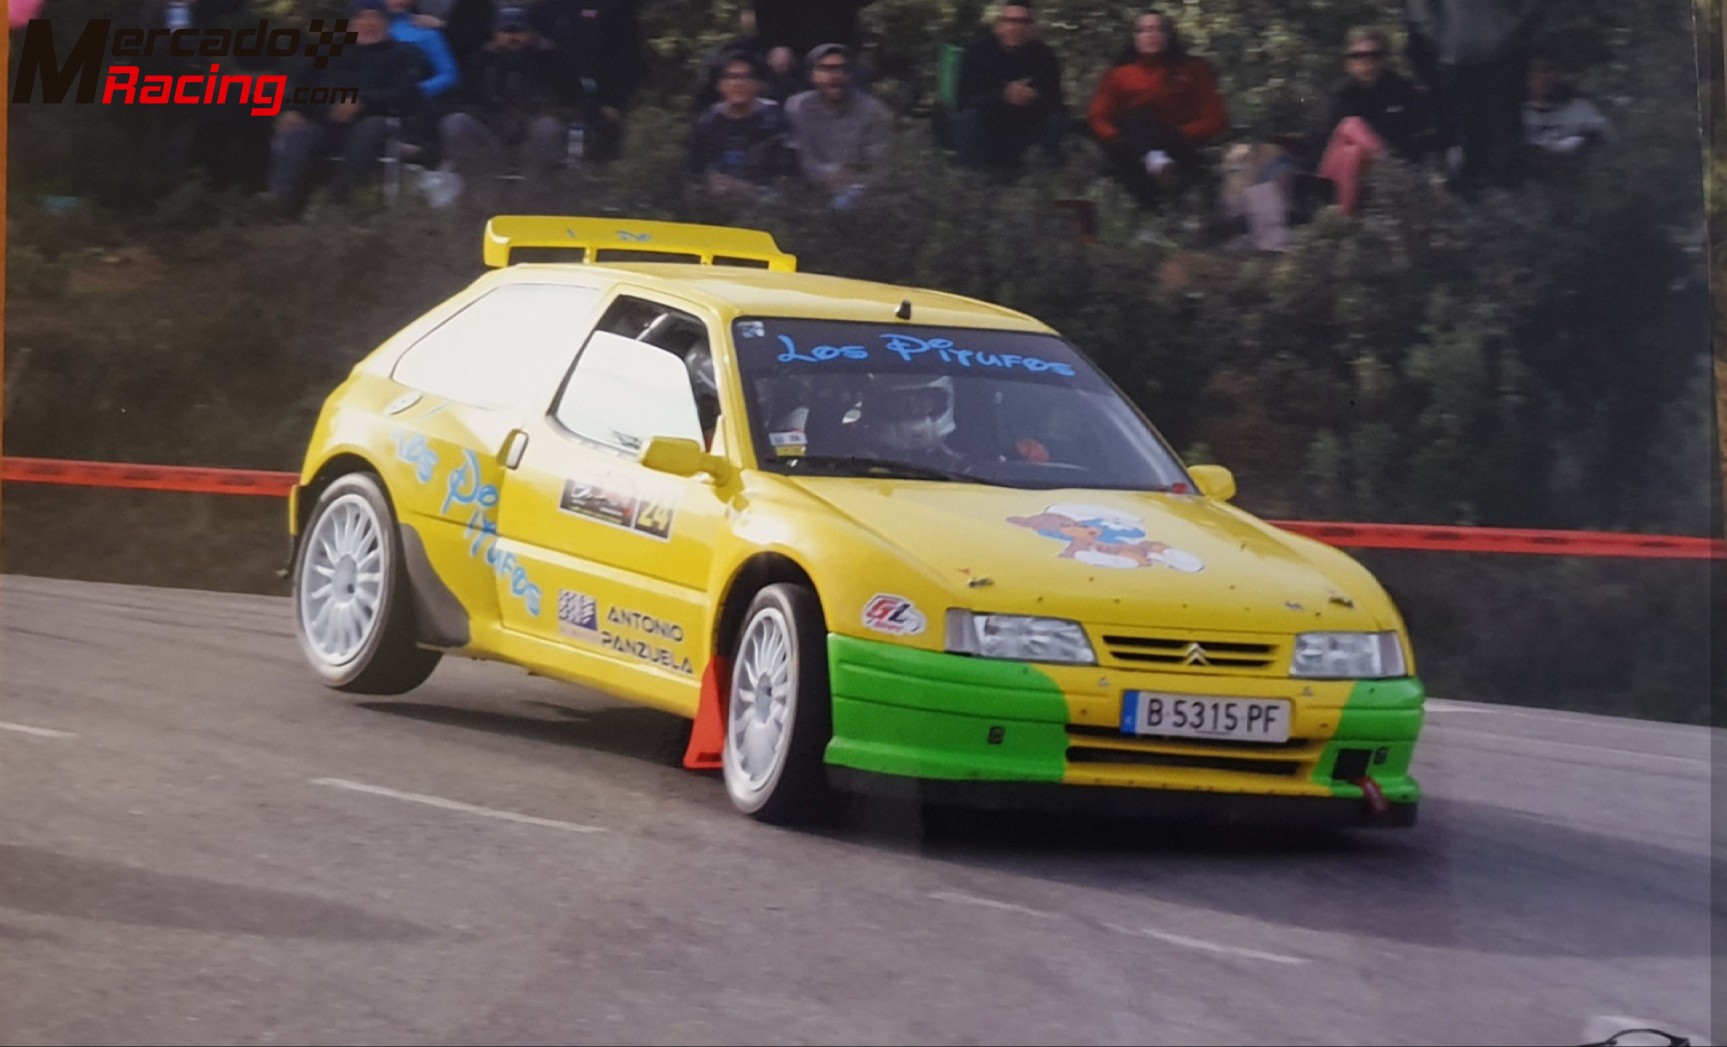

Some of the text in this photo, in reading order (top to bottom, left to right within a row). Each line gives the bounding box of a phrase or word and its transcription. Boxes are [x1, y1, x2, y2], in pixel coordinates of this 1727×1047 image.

[776, 334, 868, 363] Los
[637, 499, 671, 531] 24
[608, 606, 683, 642] ANTONIO
[601, 631, 693, 674] PANZUELA
[1147, 698, 1281, 733] B 5315 PF
